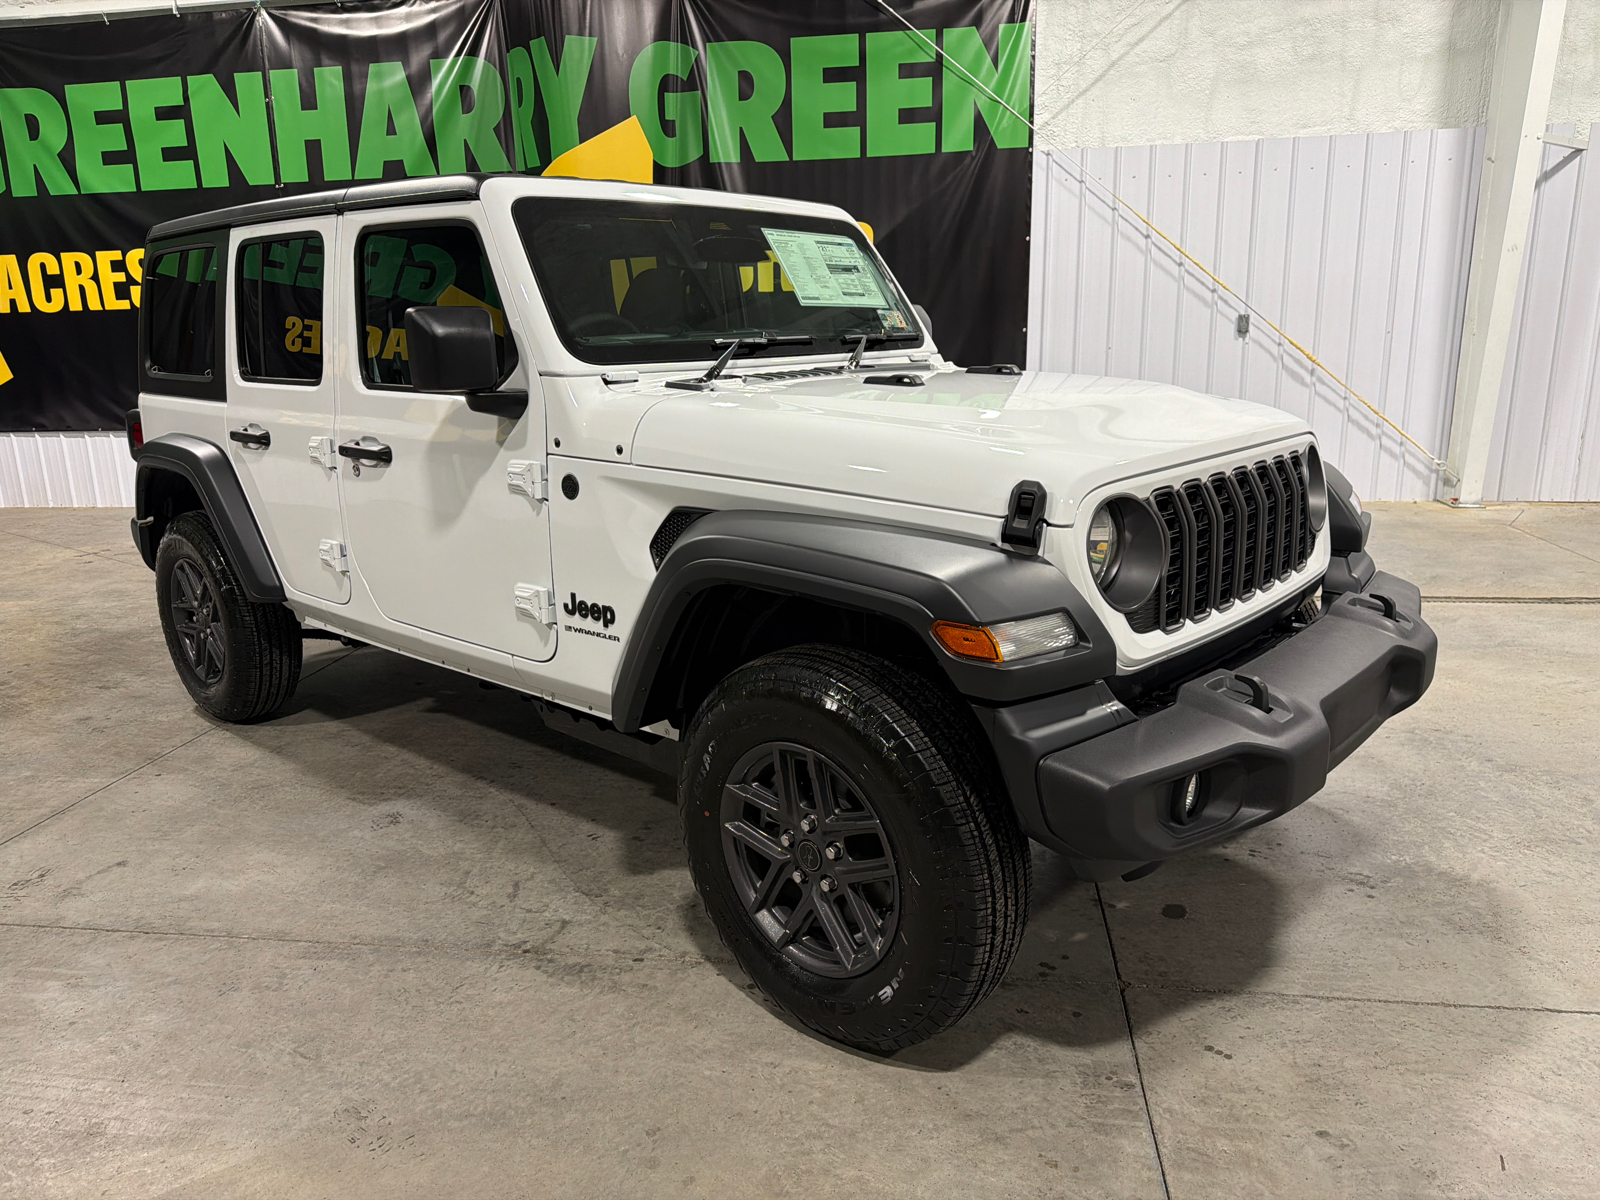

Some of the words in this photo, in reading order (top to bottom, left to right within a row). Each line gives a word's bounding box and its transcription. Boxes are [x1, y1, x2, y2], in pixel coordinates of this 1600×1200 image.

[0, 71, 276, 197] REEN
[269, 35, 598, 182] HARRY
[629, 22, 1032, 168] GREEN
[563, 592, 616, 628] Jeep
[572, 626, 621, 643] WRANGLER
